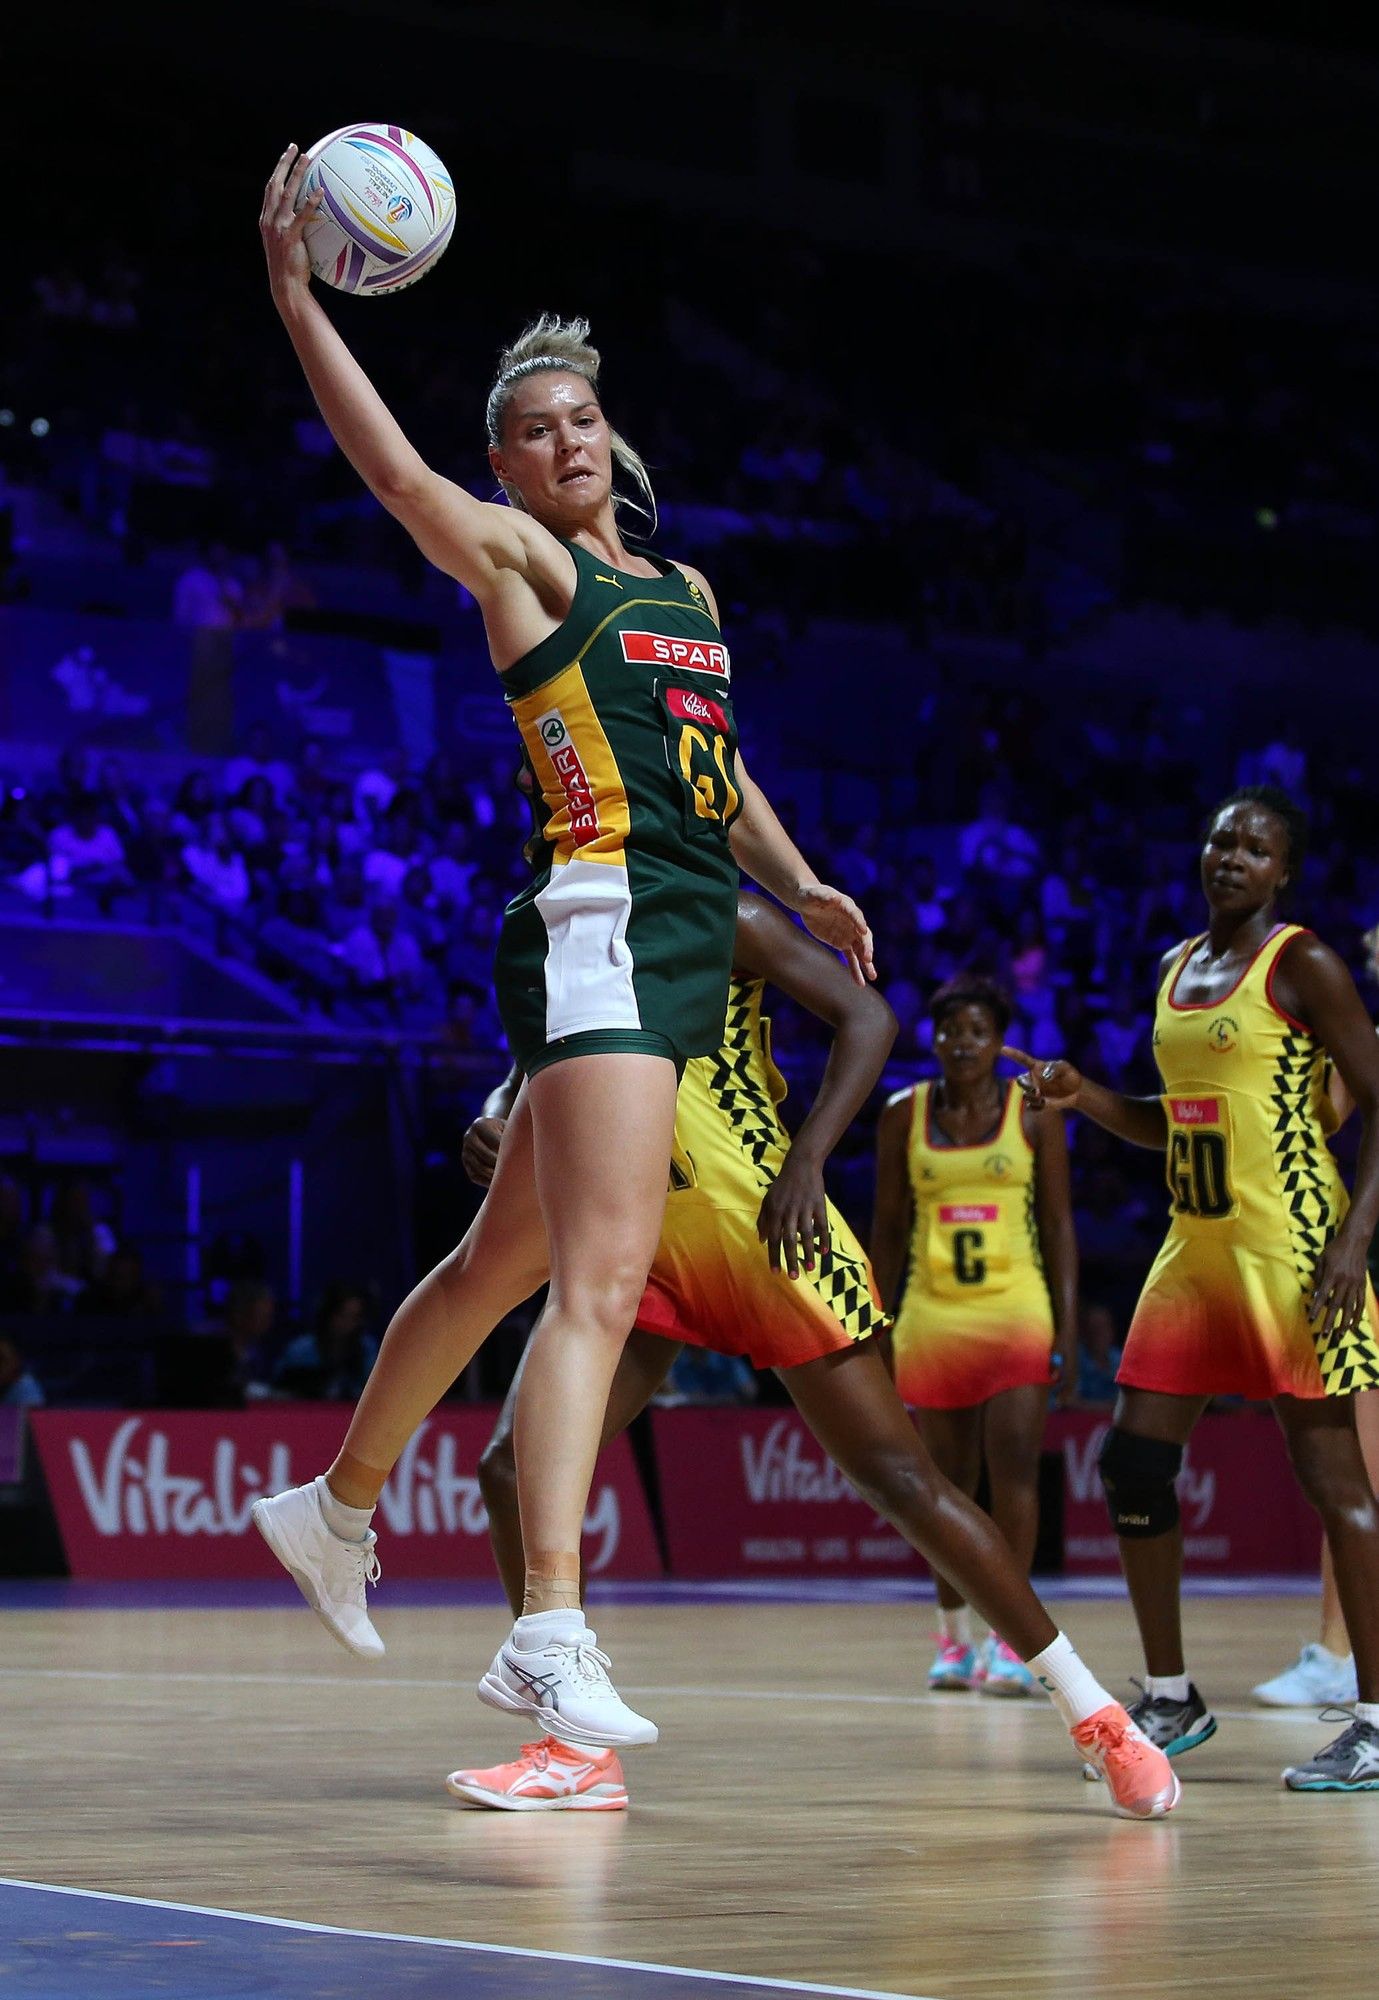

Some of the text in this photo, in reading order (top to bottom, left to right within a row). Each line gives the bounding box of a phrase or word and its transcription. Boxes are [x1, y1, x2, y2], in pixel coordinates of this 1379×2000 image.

[368, 176, 389, 200] NETBALL
[652, 638, 724, 671] SPAR
[556, 749, 593, 828] SPAR
[1170, 1130, 1234, 1218] GD
[952, 1227, 985, 1286] C
[68, 1417, 300, 1536] Vitalit
